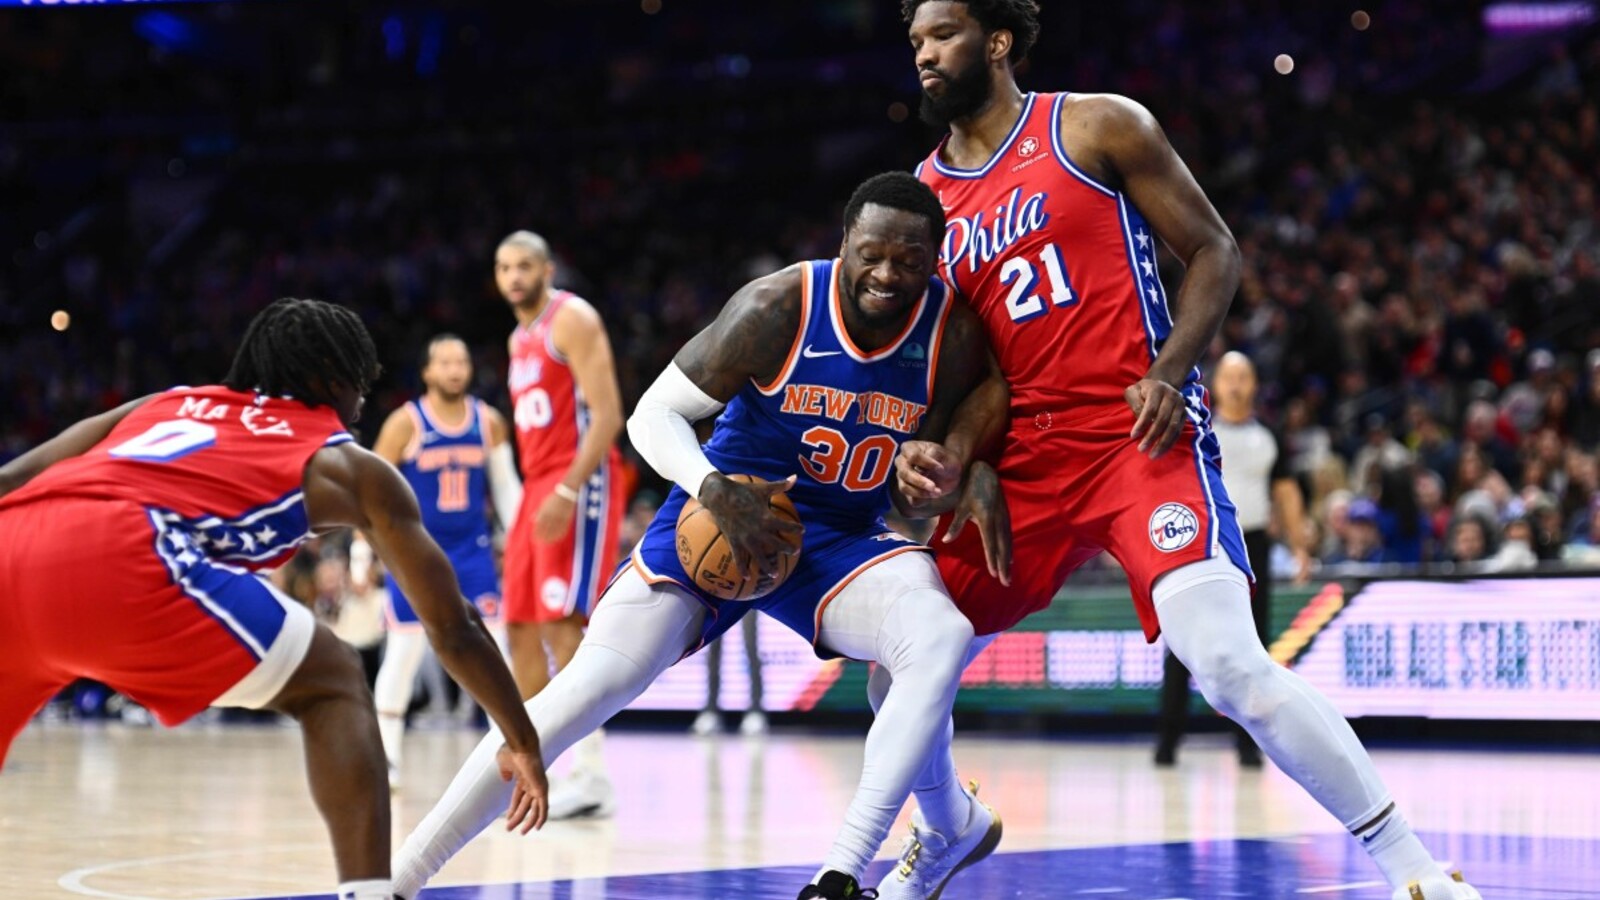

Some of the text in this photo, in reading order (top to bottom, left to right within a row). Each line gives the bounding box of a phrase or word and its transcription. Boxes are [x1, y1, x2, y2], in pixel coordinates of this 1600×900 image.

[939, 187, 1050, 293] Phila
[1000, 243, 1079, 325] 21
[780, 384, 928, 434] NEW YORK
[108, 418, 216, 463] 0
[798, 425, 898, 492] 30
[437, 470, 469, 513] 11
[1153, 520, 1195, 544] 76ers
